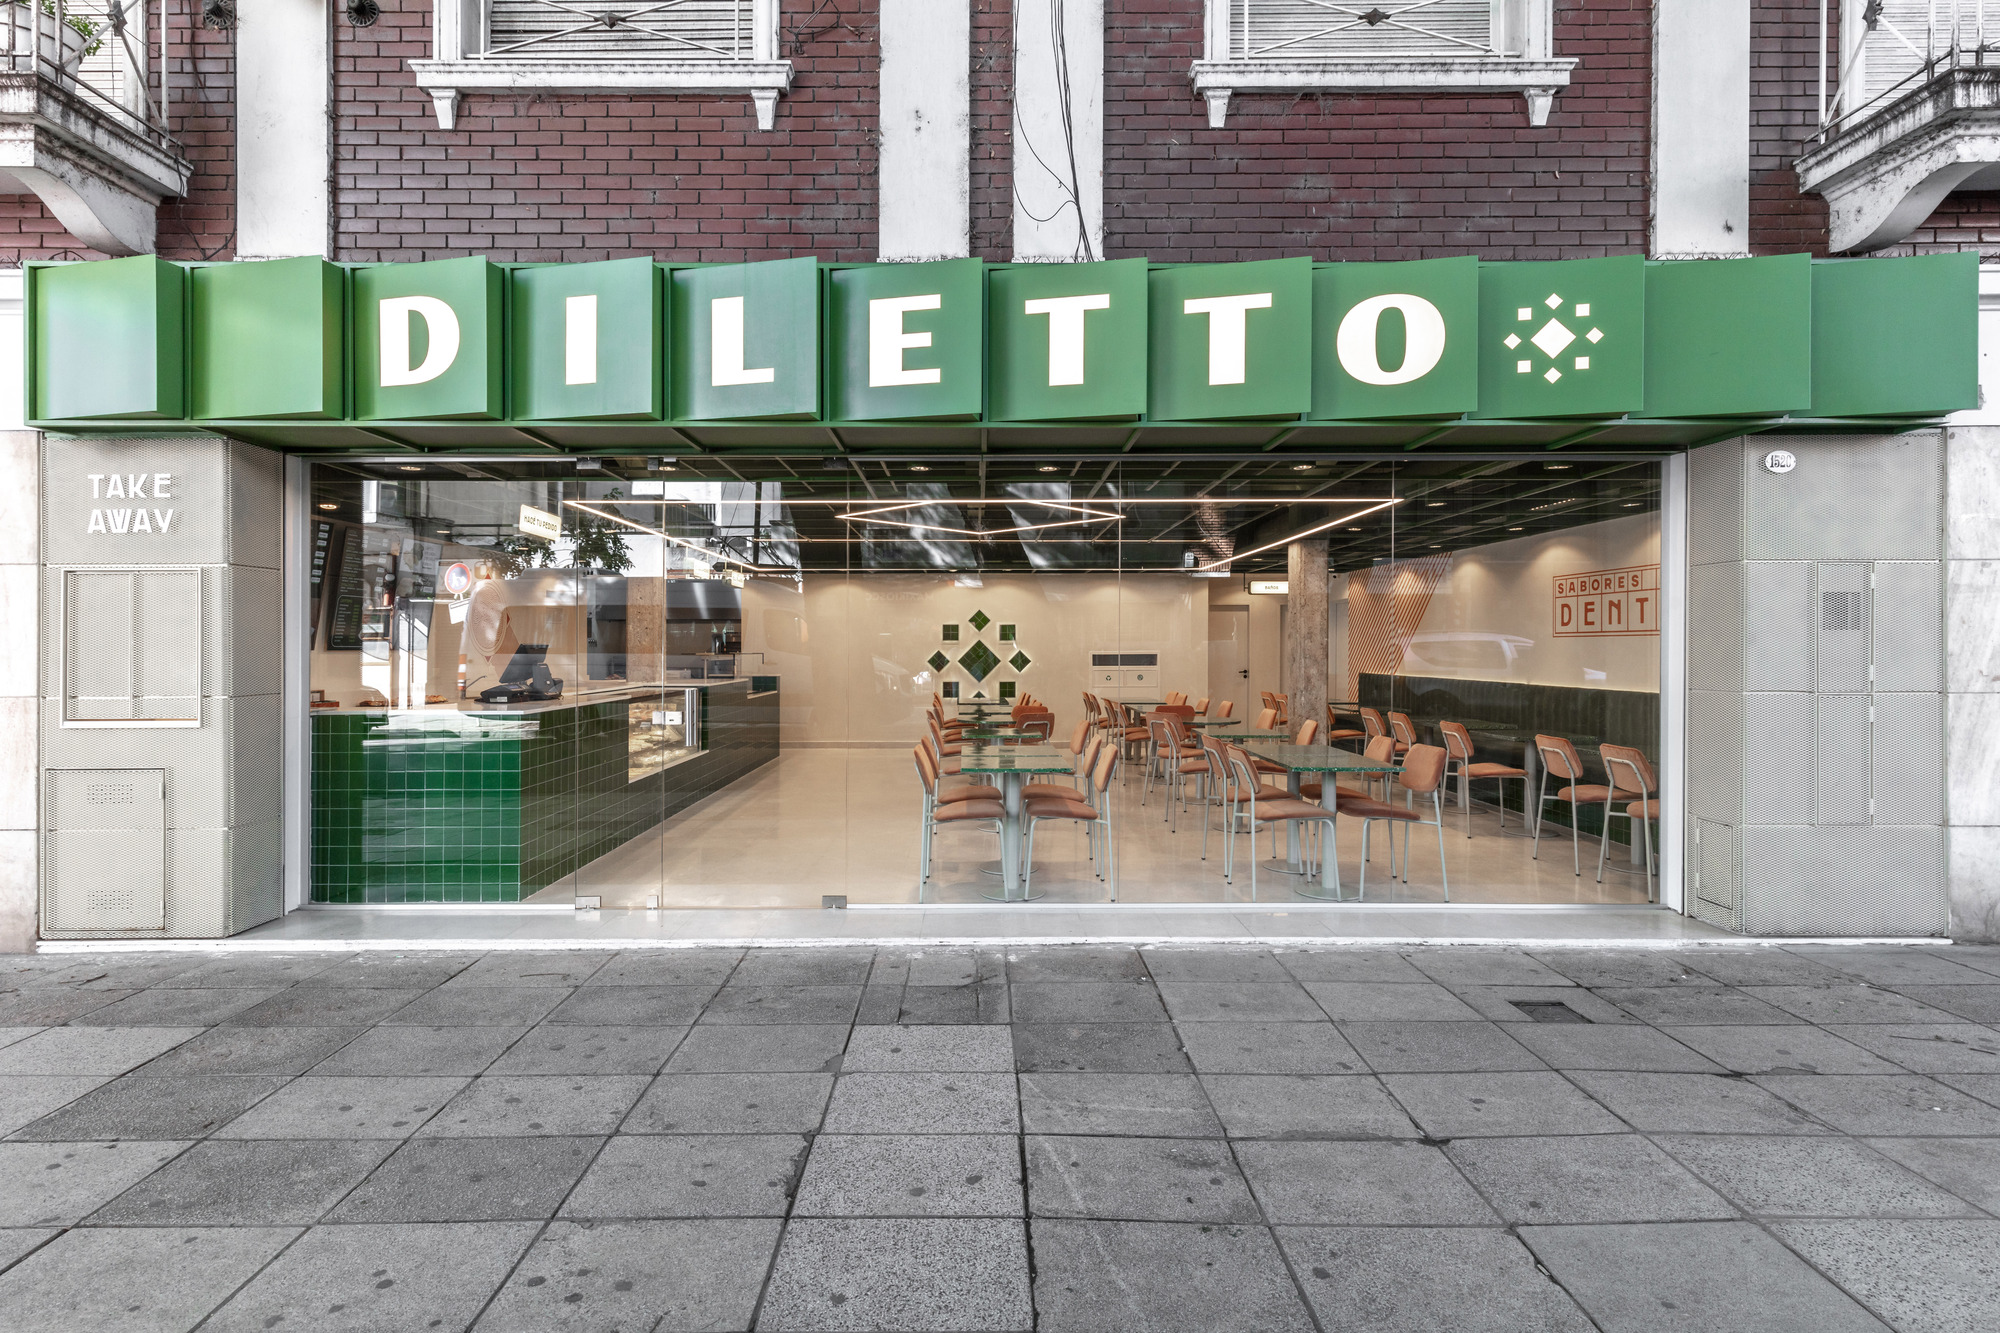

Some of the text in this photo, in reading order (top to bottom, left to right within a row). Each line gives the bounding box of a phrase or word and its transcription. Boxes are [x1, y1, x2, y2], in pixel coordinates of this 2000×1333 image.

[379, 292, 1446, 387] DILETTO
[1770, 455, 1791, 467] 1520
[88, 473, 171, 498] TAKE
[87, 508, 174, 533] AWAY
[1557, 574, 1639, 594] SABORES
[1561, 597, 1649, 627] DENT
